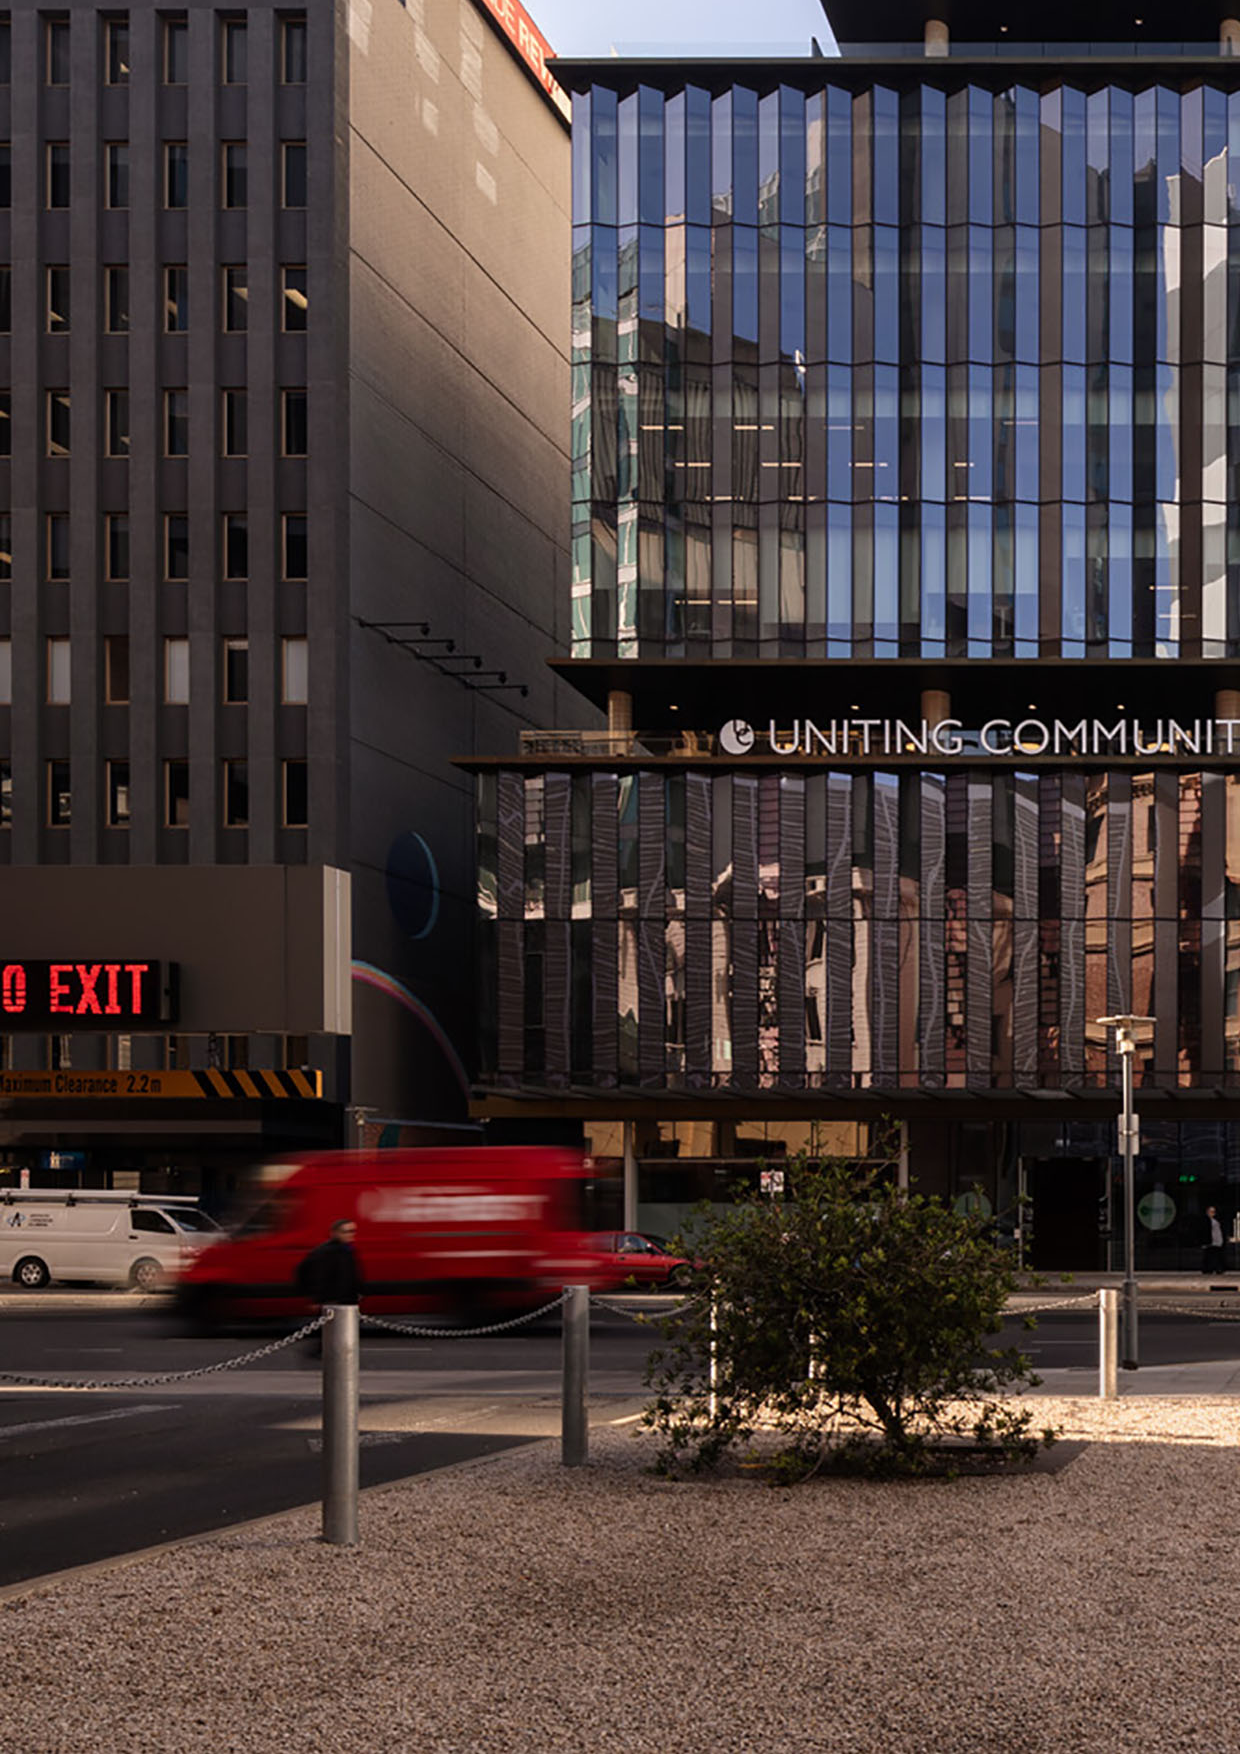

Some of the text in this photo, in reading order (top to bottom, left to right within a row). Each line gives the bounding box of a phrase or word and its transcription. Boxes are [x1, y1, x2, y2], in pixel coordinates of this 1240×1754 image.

[770, 719, 963, 754] UNITING
[50, 964, 149, 1014] EXIT
[55, 1074, 118, 1093] Clearance
